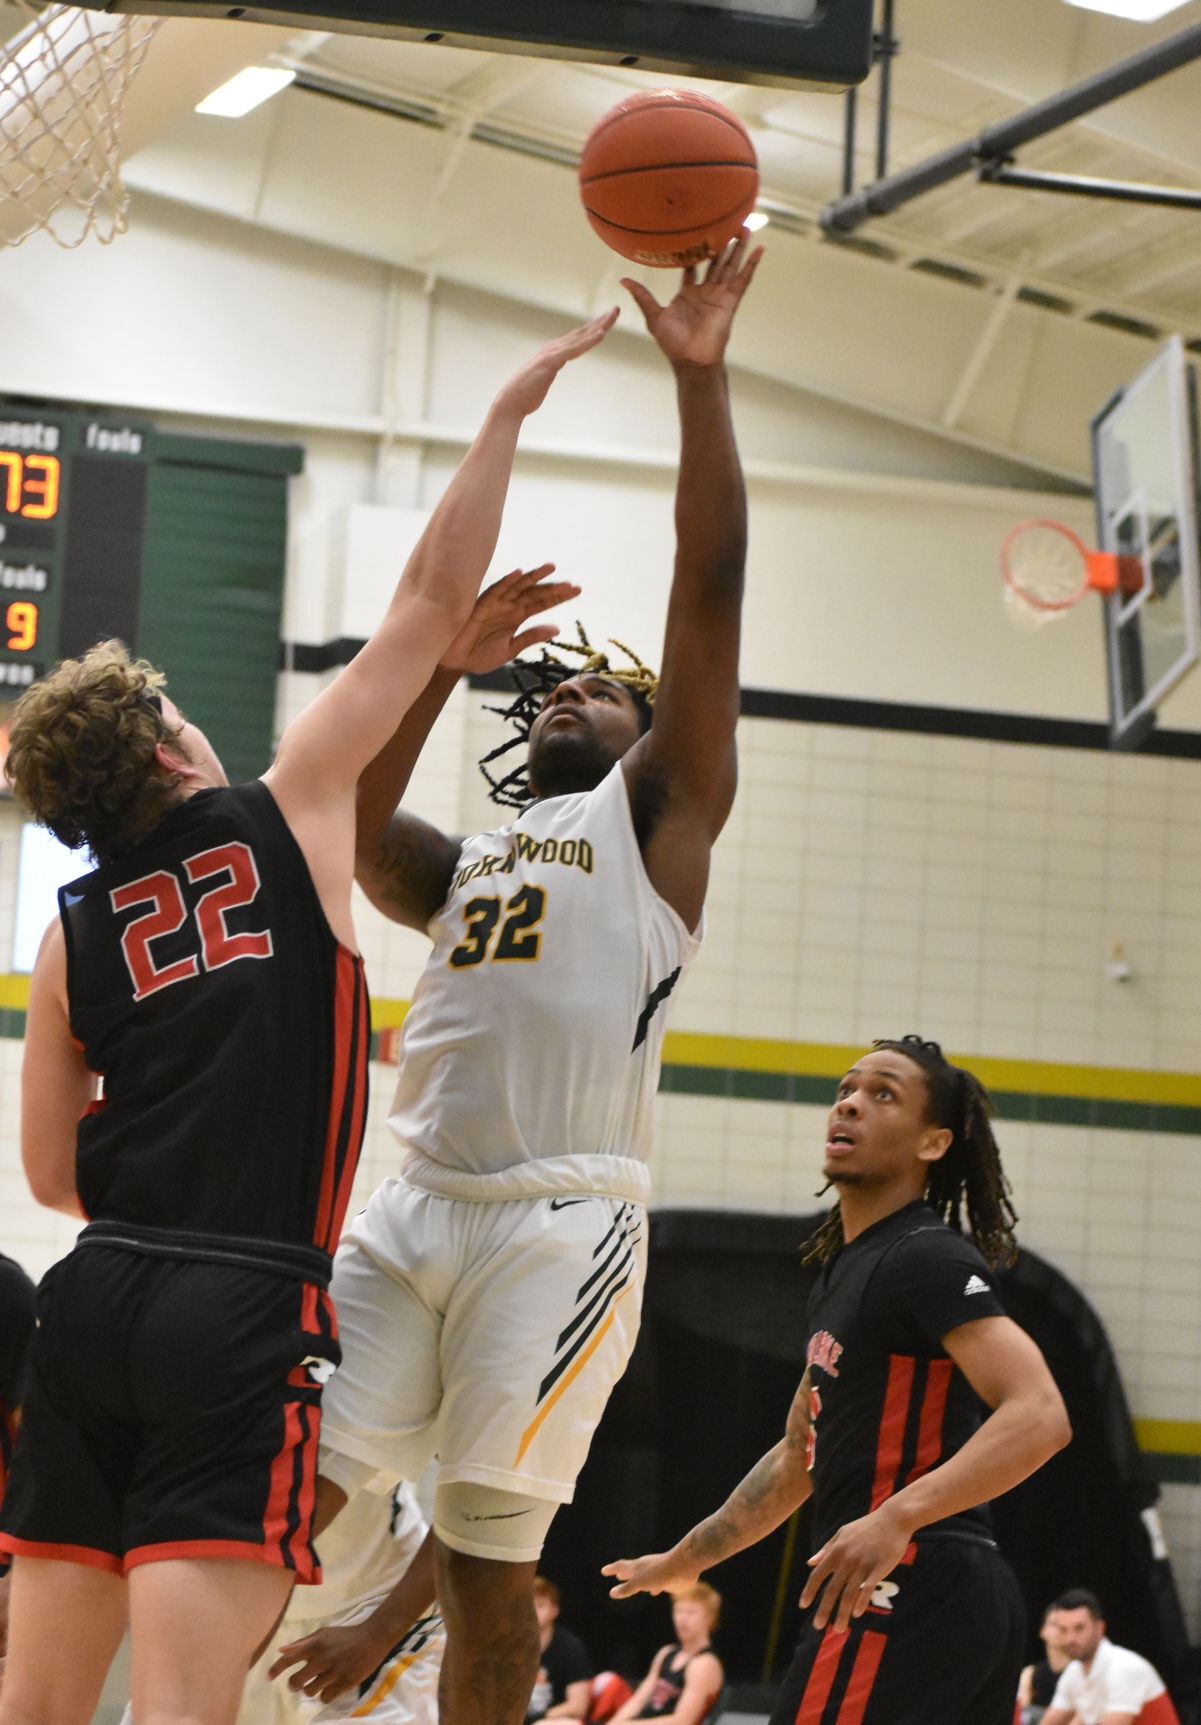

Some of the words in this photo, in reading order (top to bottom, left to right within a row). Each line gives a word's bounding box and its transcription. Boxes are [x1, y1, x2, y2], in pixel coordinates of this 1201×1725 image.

[0, 450, 60, 519] 73
[6, 601, 38, 651] 9
[109, 840, 274, 1003] 22
[448, 881, 547, 971] 32
